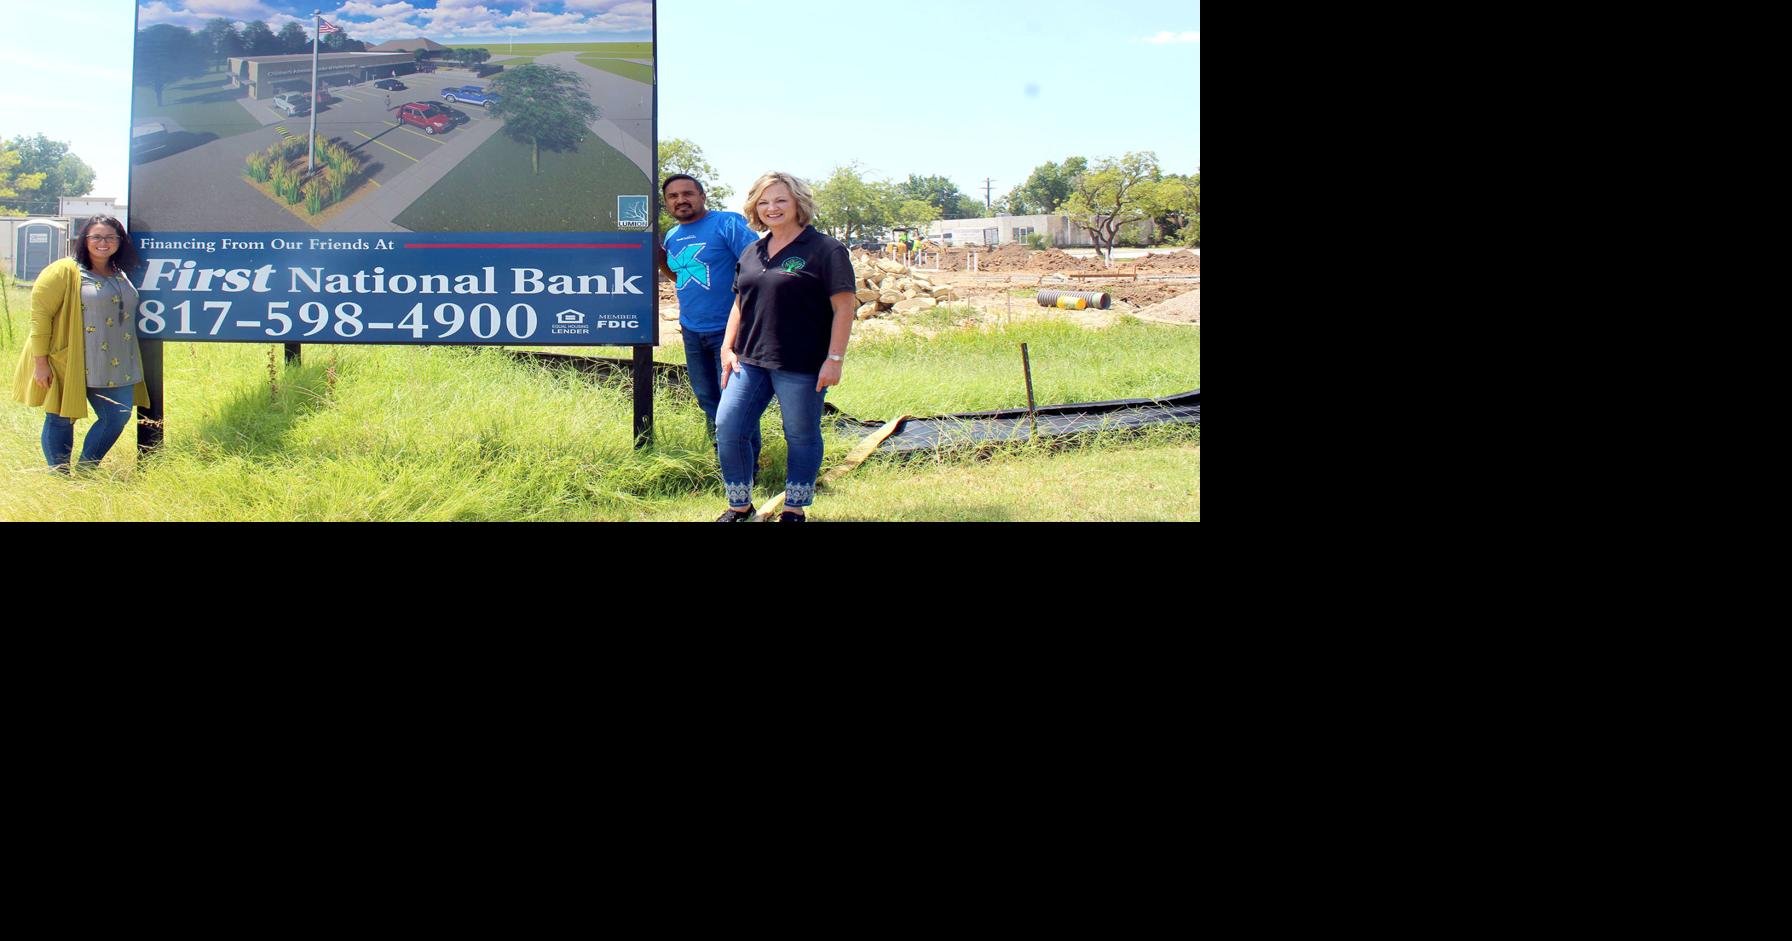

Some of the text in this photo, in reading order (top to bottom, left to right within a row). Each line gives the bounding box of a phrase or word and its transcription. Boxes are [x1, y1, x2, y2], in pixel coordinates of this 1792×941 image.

[140, 238, 395, 252] Financing From Our Friends At
[137, 258, 644, 295] First National Bank
[138, 299, 538, 339] 817-598-4900
[597, 320, 640, 329] FDIC
